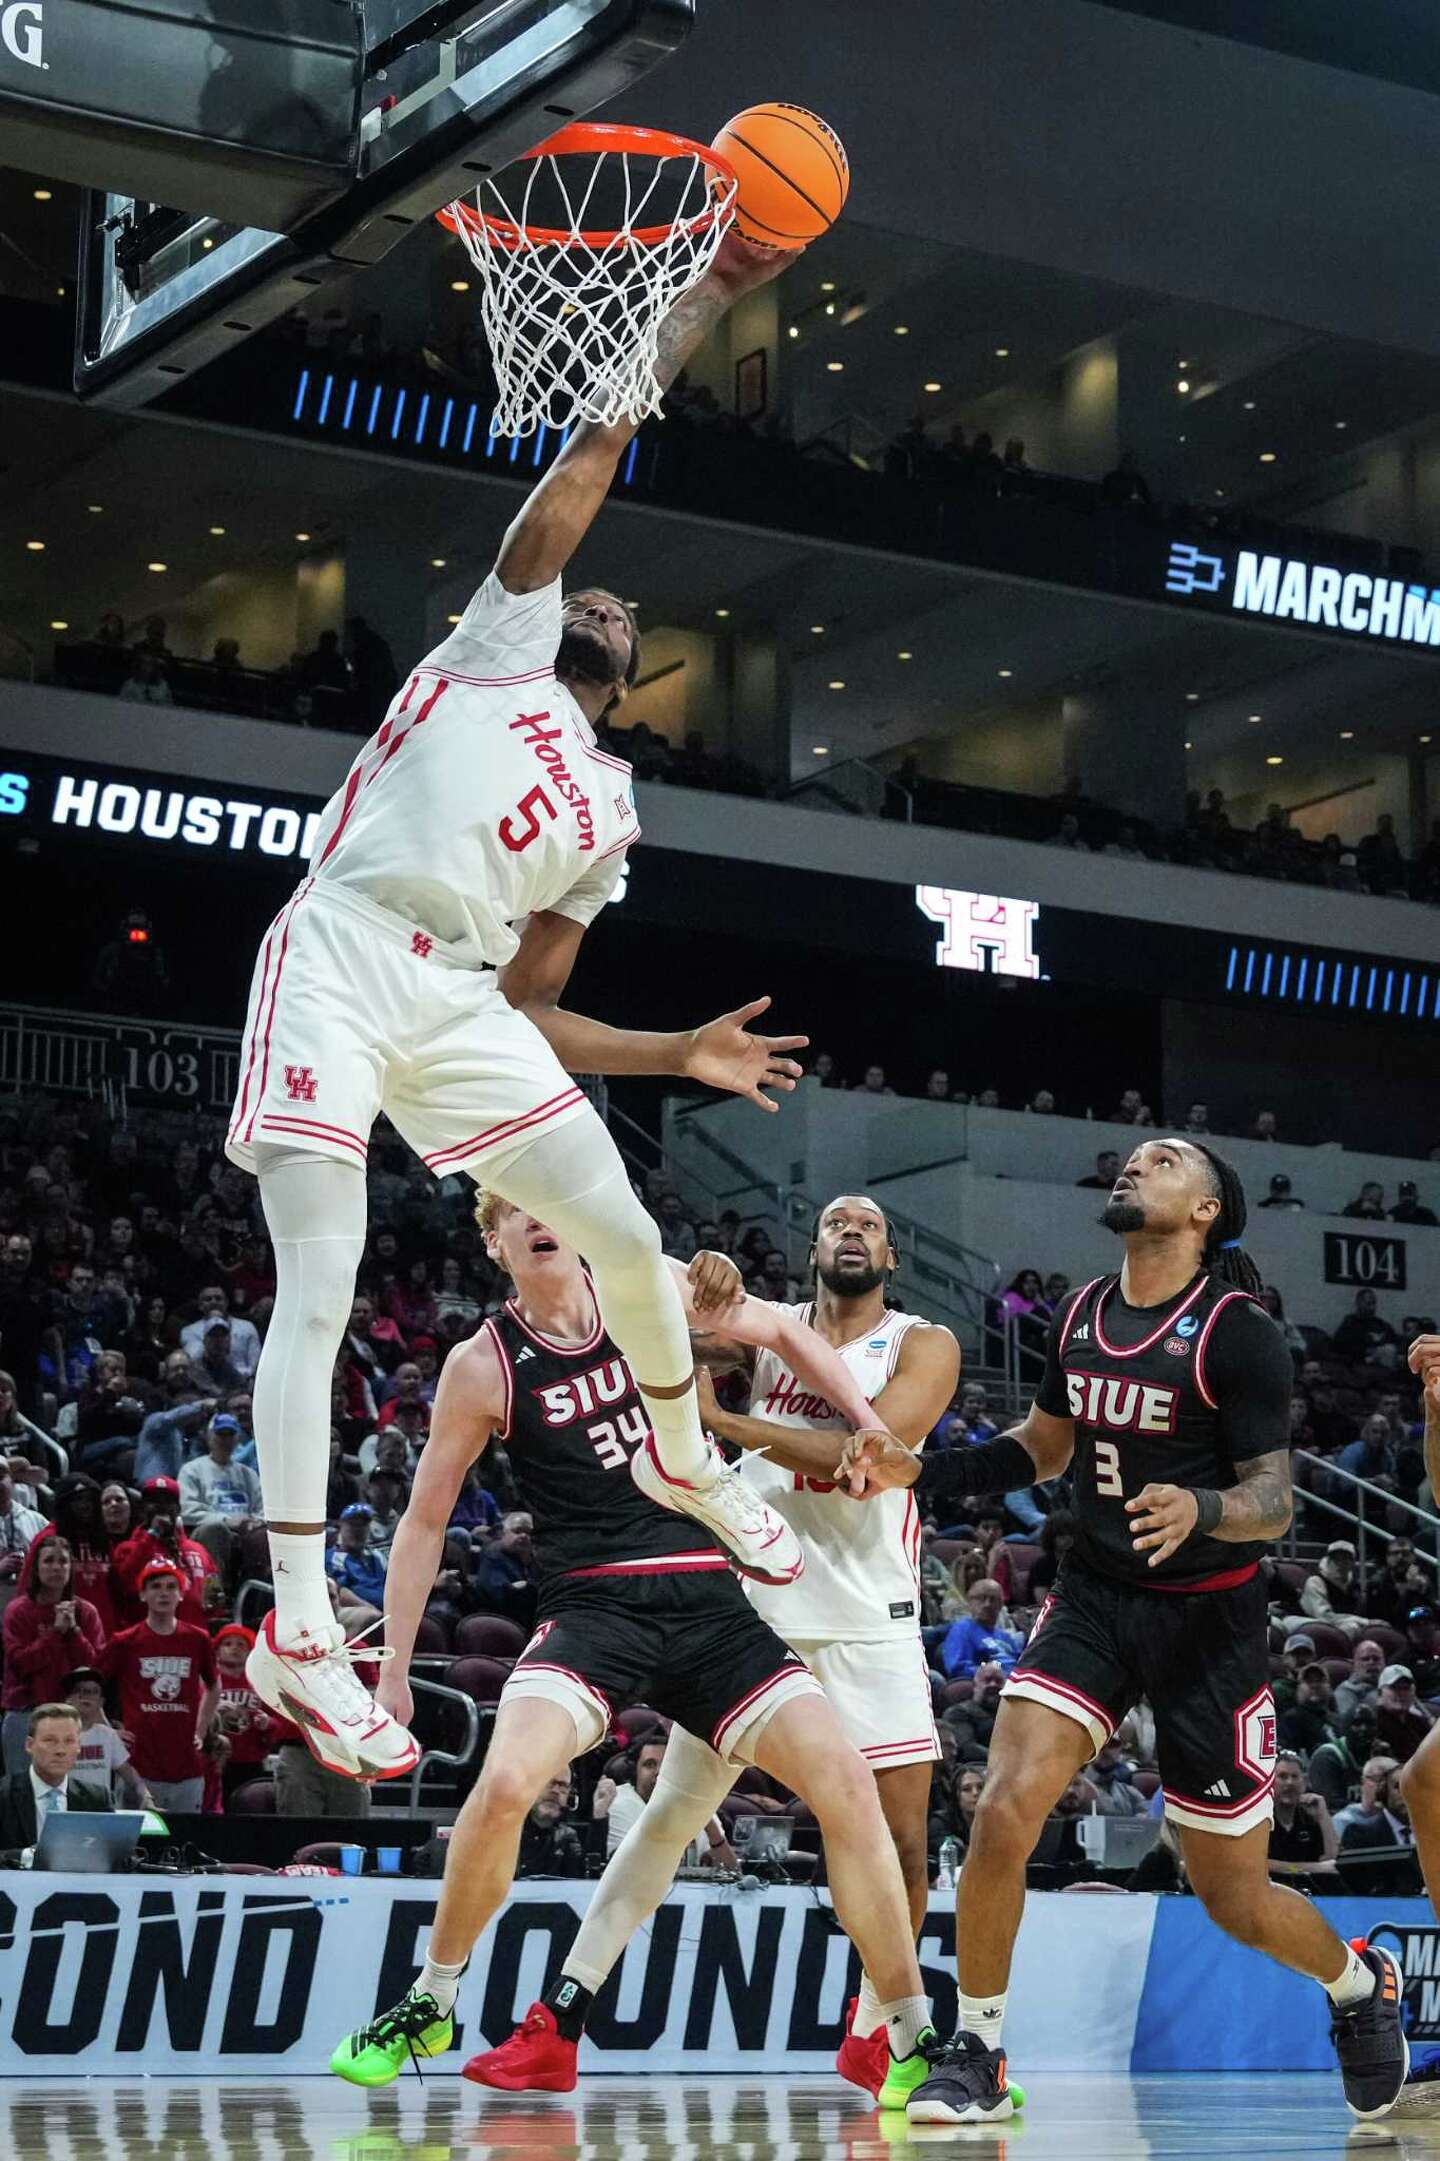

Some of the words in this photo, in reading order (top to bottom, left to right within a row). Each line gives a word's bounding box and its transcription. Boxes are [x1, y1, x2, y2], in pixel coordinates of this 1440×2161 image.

[509, 711, 595, 850] Houston
[499, 784, 558, 852] 5
[126, 1048, 199, 1096] 103
[1336, 1239, 1400, 1283] 104
[766, 1373, 876, 1420] Hous
[1065, 1373, 1174, 1432] SIUE
[587, 1405, 649, 1470] 34
[1095, 1441, 1124, 1497] 3
[0, 1889, 324, 2055] OND
